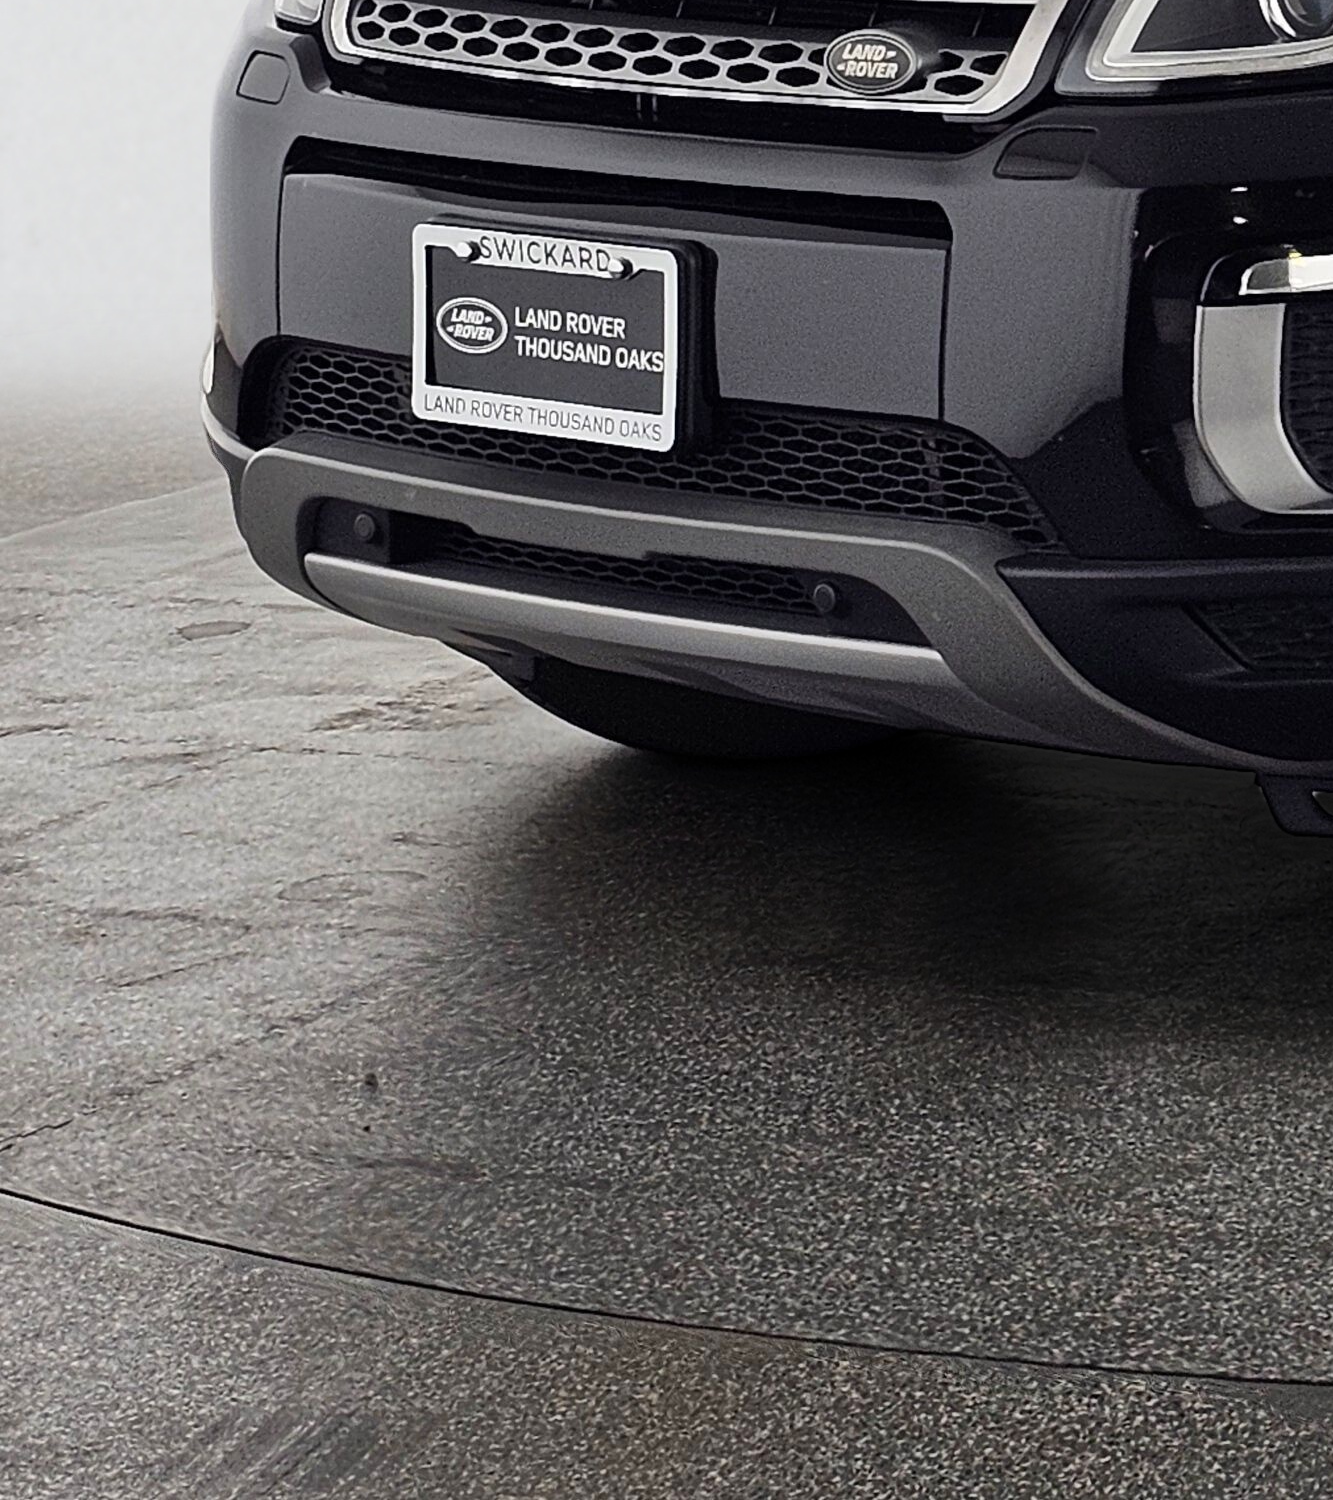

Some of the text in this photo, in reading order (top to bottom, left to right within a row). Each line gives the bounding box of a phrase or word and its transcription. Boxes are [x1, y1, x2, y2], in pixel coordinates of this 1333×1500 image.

[841, 43, 887, 61] LAND
[844, 61, 899, 79] ROVER
[479, 235, 611, 272] SWICKARD
[450, 306, 485, 325] LAND
[514, 306, 626, 339] LAND ROVER
[453, 325, 495, 342] ROVER
[514, 335, 664, 373] THOUSAND OAKS
[424, 393, 662, 442] LAND ROVER THOUSAND OAKS
